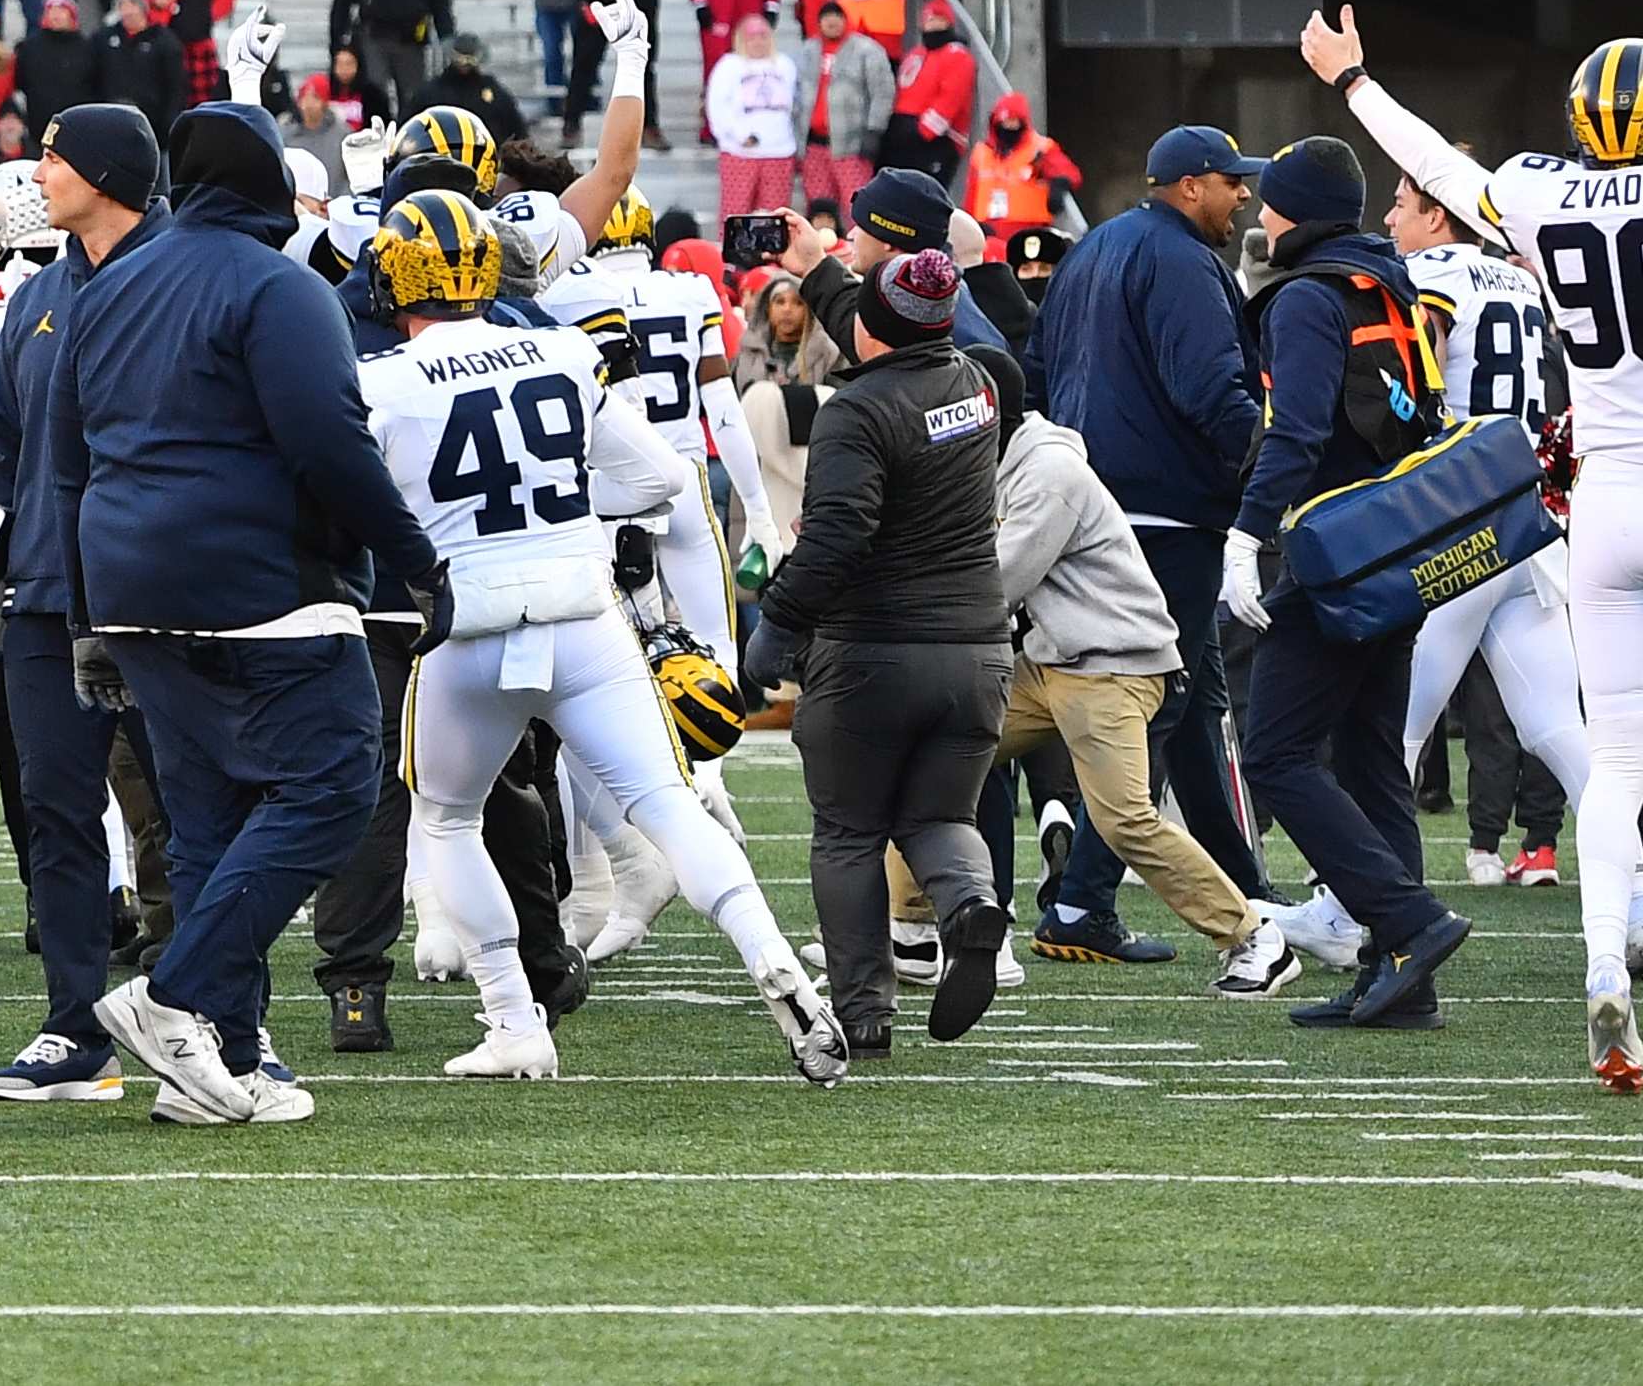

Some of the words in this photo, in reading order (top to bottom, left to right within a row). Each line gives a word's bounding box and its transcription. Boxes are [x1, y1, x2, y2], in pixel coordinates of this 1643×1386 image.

[417, 340, 545, 385] WAGNER
[629, 316, 690, 423] 5
[928, 403, 975, 430] WTOL
[428, 373, 591, 537] 49
[1410, 525, 1497, 587] MICHIGAN
[1418, 549, 1509, 608] FOOTBALL
